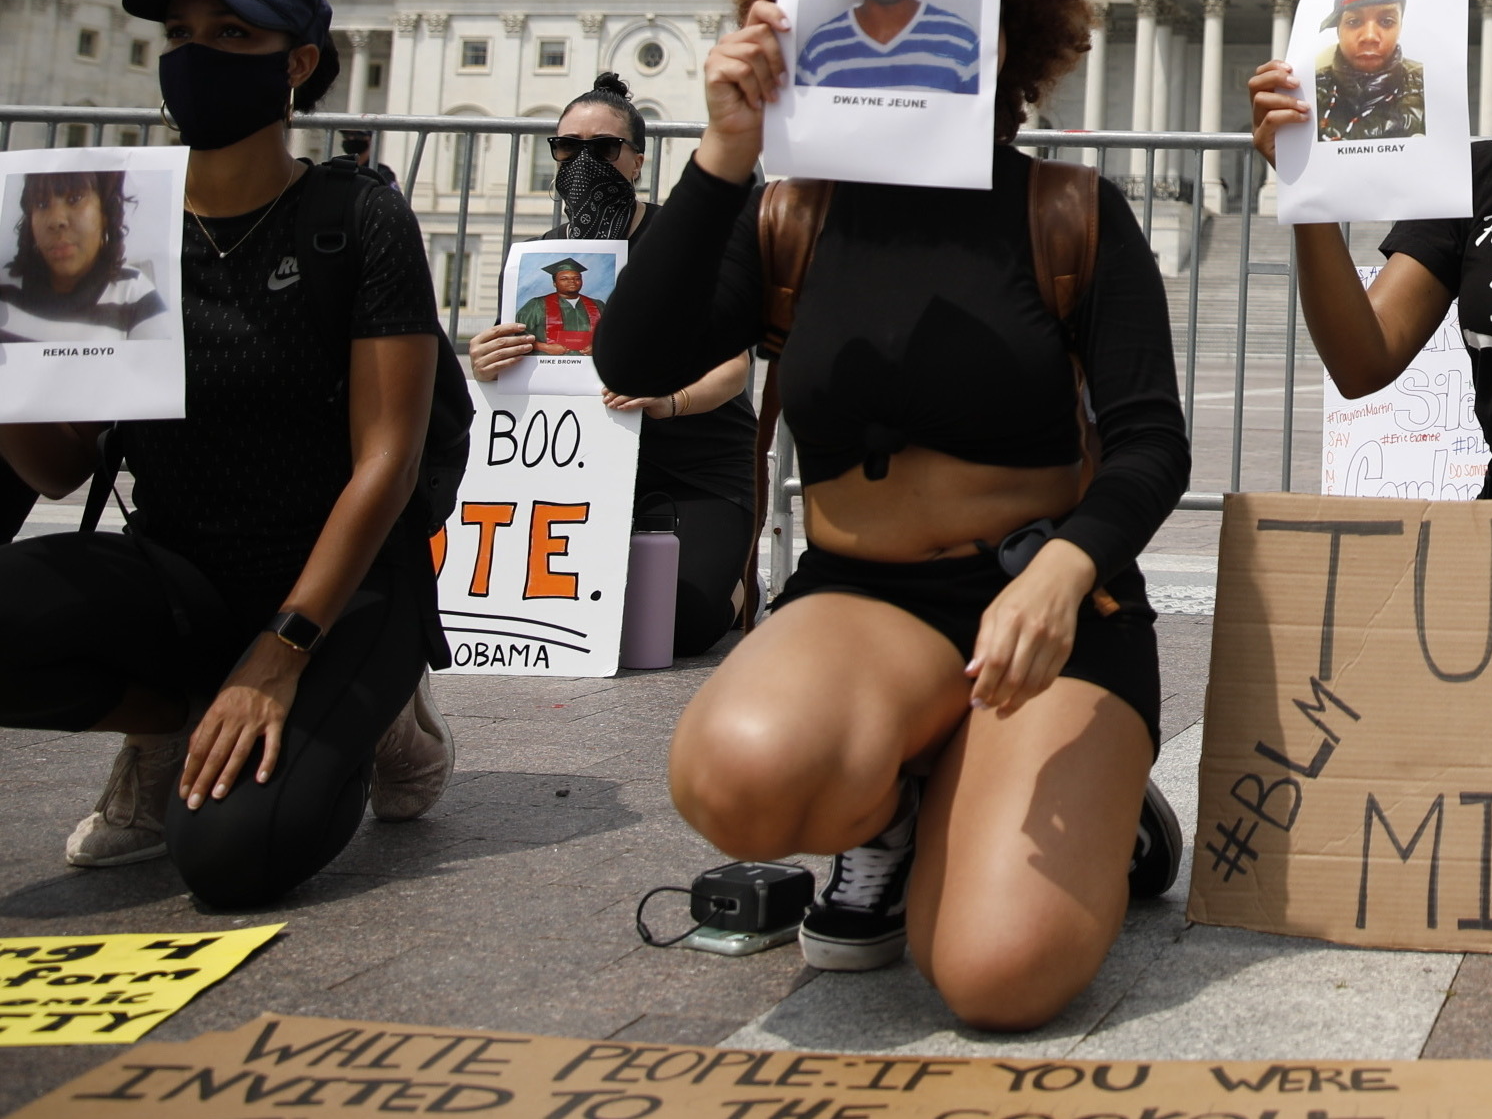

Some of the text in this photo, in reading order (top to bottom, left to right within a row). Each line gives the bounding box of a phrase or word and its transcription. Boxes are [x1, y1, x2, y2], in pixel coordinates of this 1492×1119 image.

[833, 95, 928, 109] DWAYNE JEUNE
[1337, 144, 1406, 155] KIMANI GRAY
[43, 347, 115, 357] REKIA BOYD
[487, 409, 585, 469] BOO.
[430, 500, 601, 601] TE.
[454, 641, 550, 669] OBAMA
[1206, 676, 1362, 882] #BLM
[0, 942, 105, 964] ng
[0, 965, 202, 987] form
[243, 1020, 532, 1075] WHITE
[993, 1062, 1152, 1094] YOU
[1209, 1063, 1400, 1094] WERE
[71, 1064, 513, 1113] INVITED
